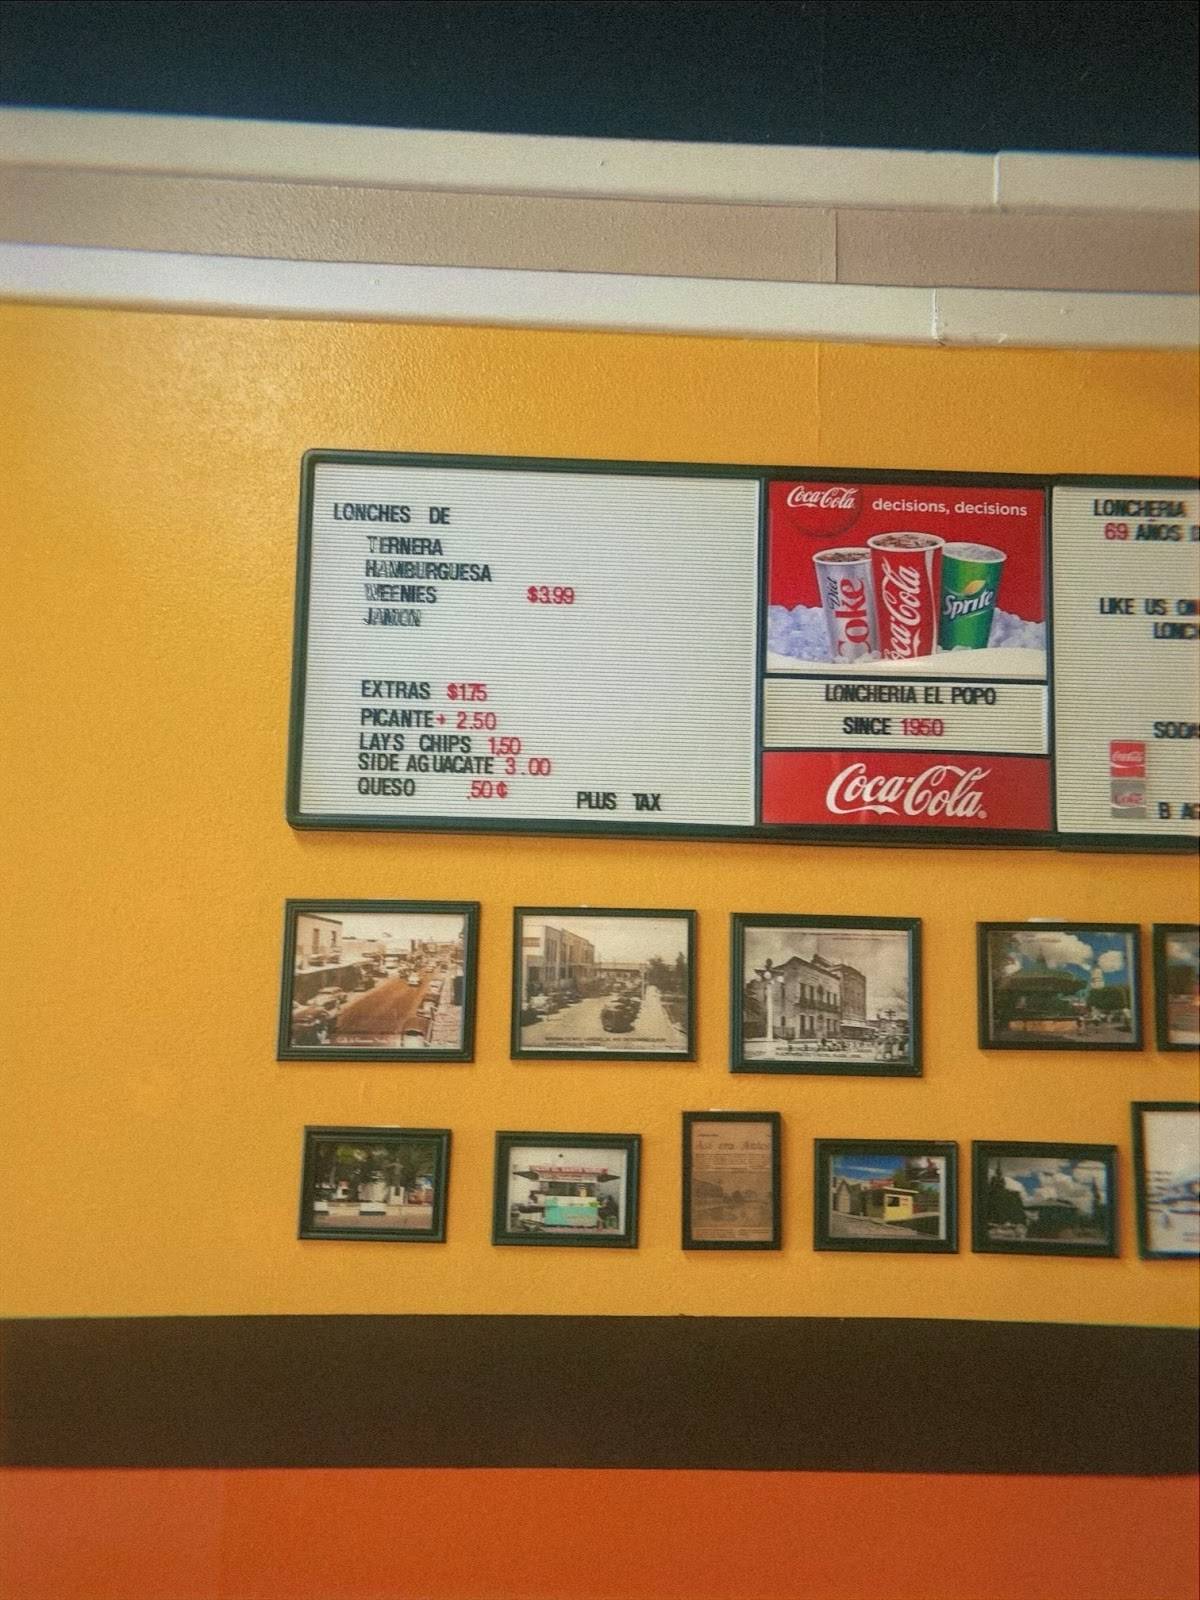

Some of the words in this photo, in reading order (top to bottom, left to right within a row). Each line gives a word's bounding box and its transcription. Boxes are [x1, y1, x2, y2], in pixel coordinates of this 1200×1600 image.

[787, 485, 859, 509] Coca-Cola
[872, 498, 950, 515] decisions,
[954, 501, 1028, 516] decisions
[333, 503, 411, 524] LONCHES
[429, 506, 451, 525] DE
[1104, 523, 1128, 540] 69
[366, 535, 443, 556] TERNERA
[365, 559, 492, 582] HAMBURGUESA
[364, 583, 437, 604] WEENIES
[943, 588, 994, 619] Sprite
[881, 556, 921, 660] oca-Cola
[1100, 597, 1135, 615] LIKE
[1145, 598, 1167, 616] US
[361, 680, 431, 699] EXTRAS
[825, 684, 917, 704] LONCHERIA
[924, 686, 943, 704] EL
[951, 687, 996, 705] POPO
[457, 711, 497, 730] 2.50
[843, 716, 891, 735] SINCE
[360, 732, 405, 751] LAYS
[419, 734, 471, 753] CHIPS
[488, 736, 522, 756] 1.50
[358, 752, 400, 772] SIDE
[406, 754, 495, 774] AGUACATE
[358, 777, 416, 796] QUESO
[825, 762, 992, 818] Coca-Cola
[577, 791, 617, 809] PLUS
[632, 793, 662, 811] TAX
